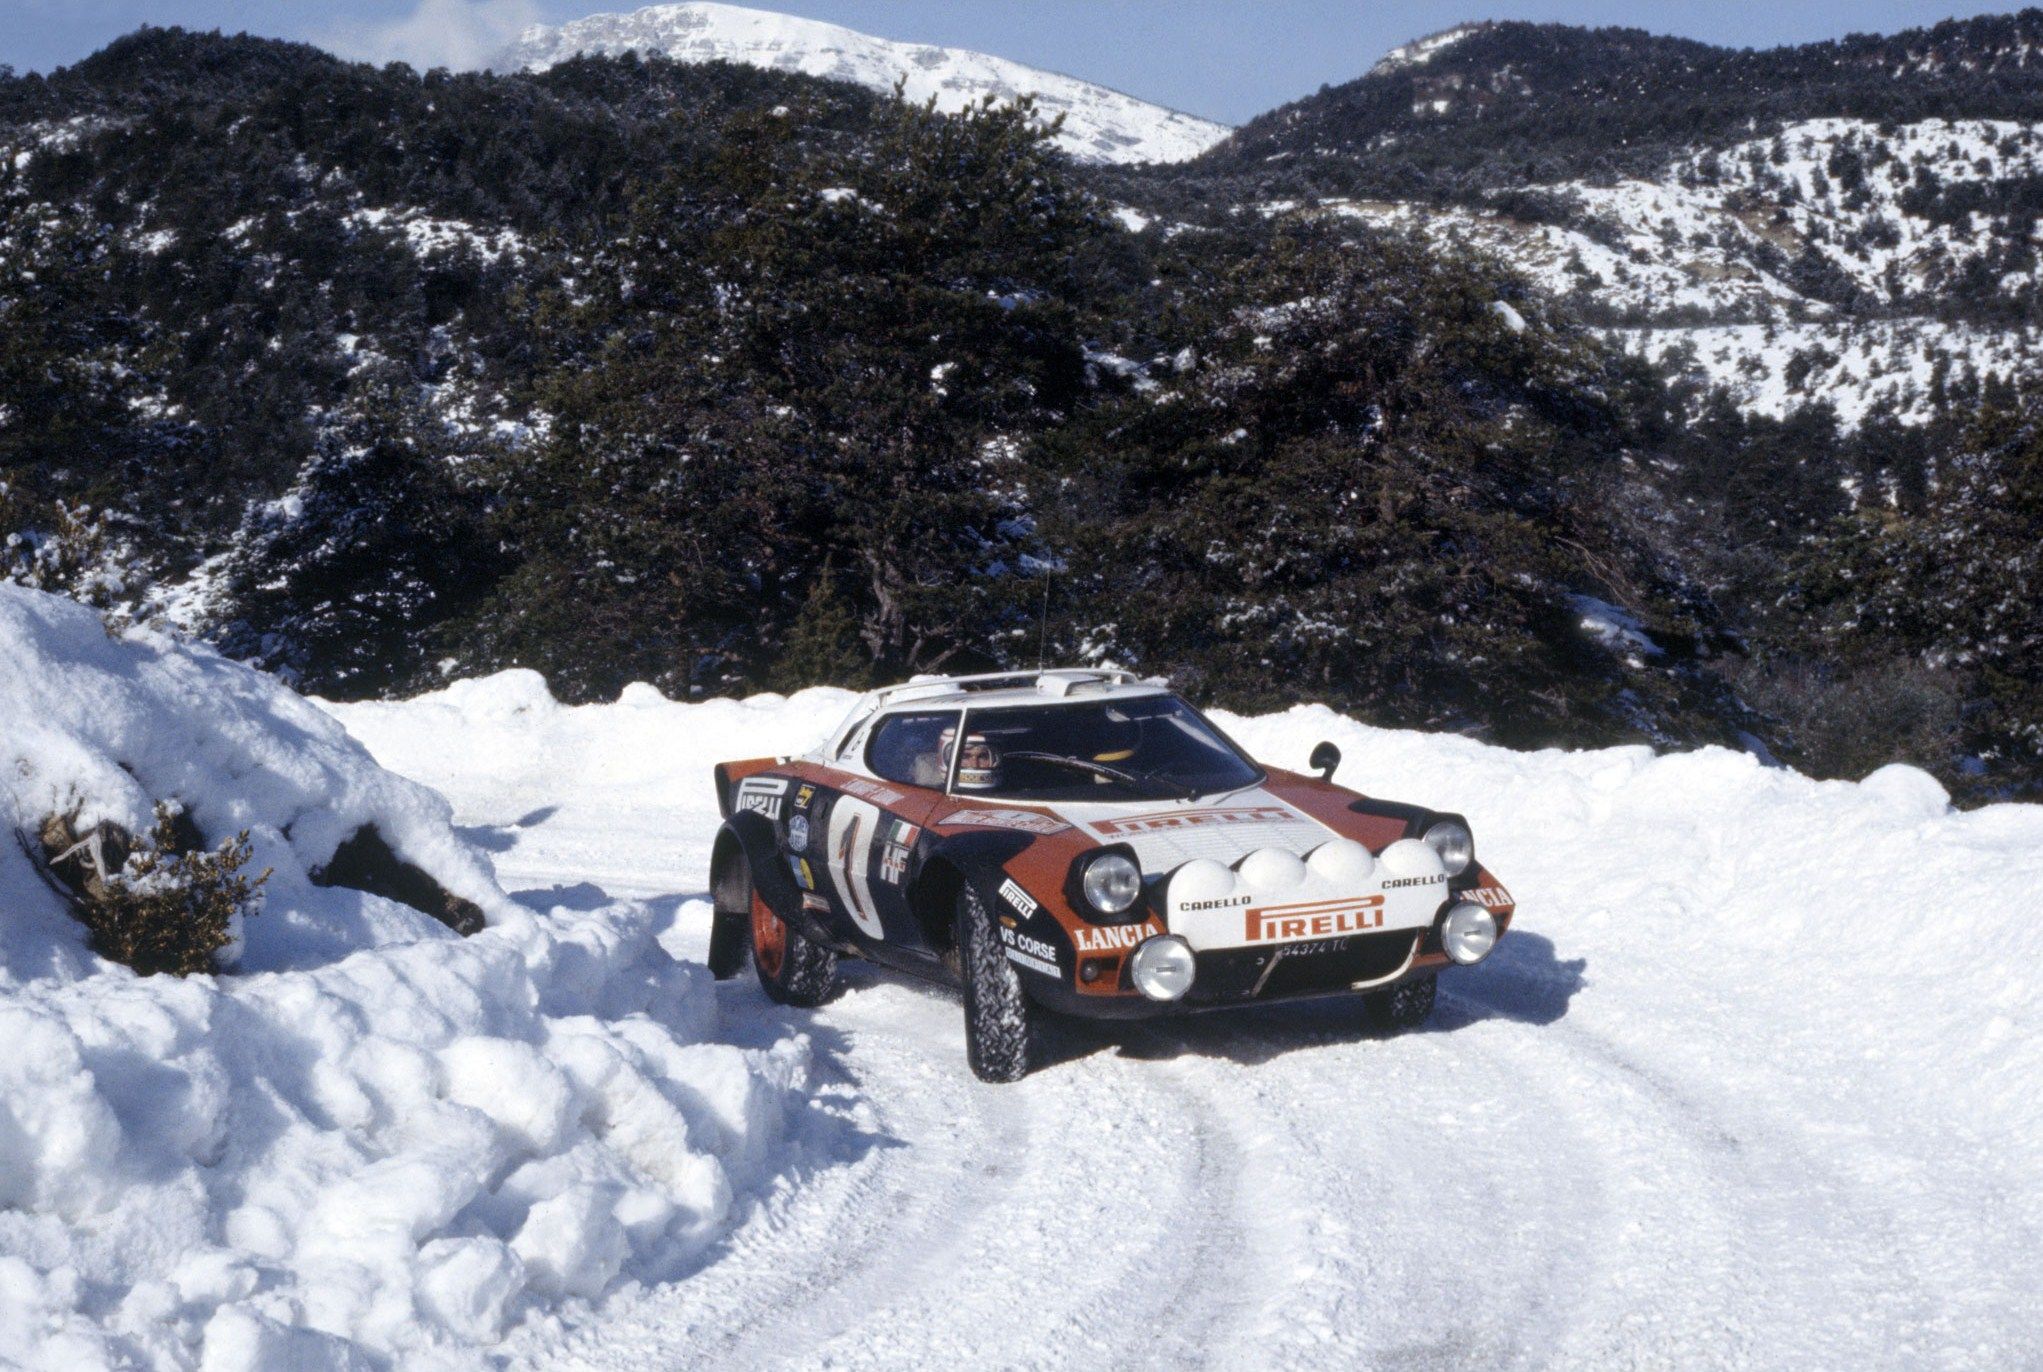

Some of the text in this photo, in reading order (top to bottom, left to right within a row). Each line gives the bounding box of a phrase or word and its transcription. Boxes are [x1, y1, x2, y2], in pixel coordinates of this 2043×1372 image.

[1086, 806, 1295, 836] PIRELLI
[1382, 874, 1445, 890] CARELLO
[998, 878, 1038, 920] PIRELLI
[1180, 896, 1252, 912] CARELLO
[1460, 887, 1514, 907] NCIA
[1245, 894, 1385, 942] PIRELLI
[1017, 933, 1057, 963] CORSE
[1073, 923, 1159, 952] LANCIA
